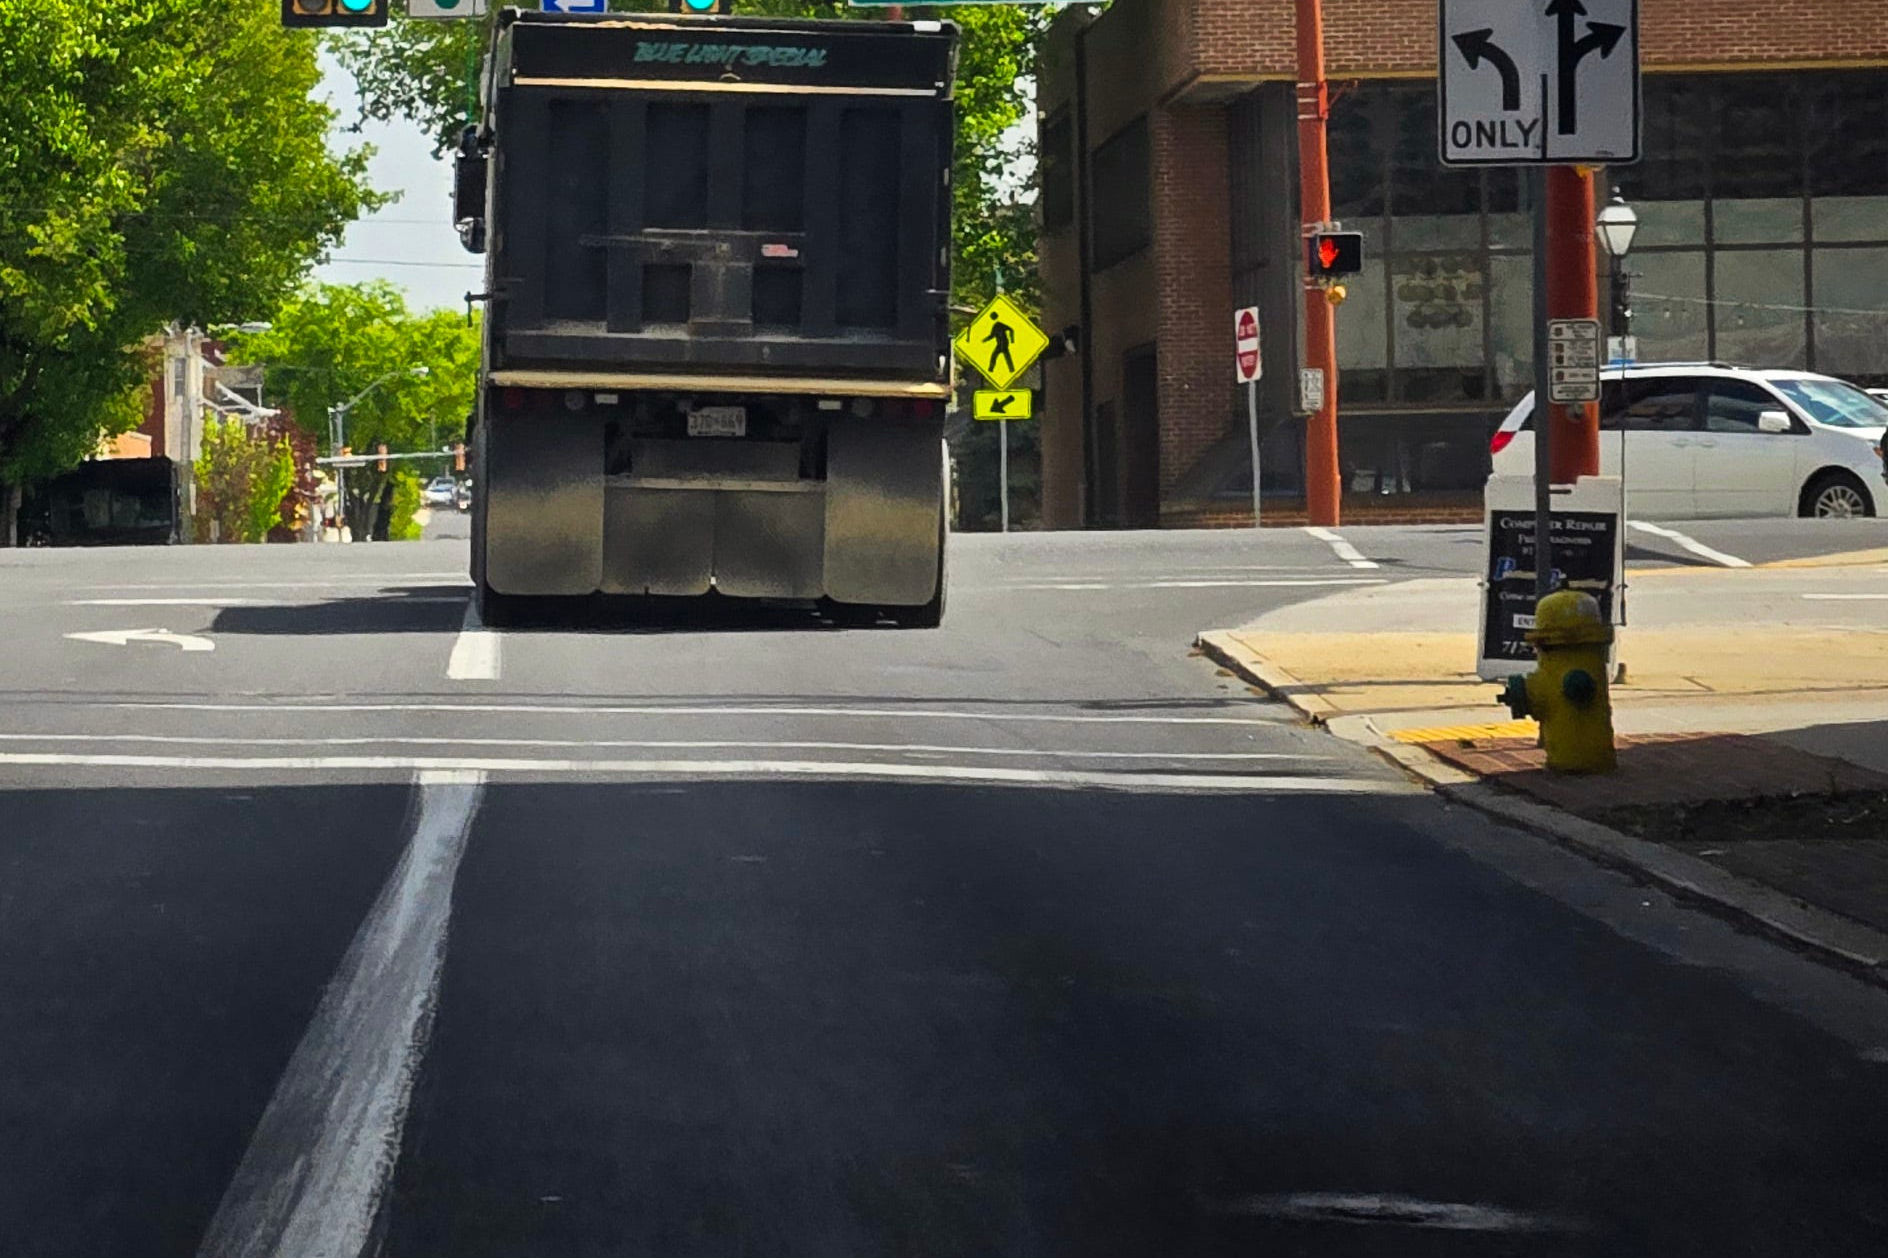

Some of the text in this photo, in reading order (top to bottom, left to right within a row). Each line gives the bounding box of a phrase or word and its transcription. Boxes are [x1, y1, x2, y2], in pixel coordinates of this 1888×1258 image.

[634, 42, 689, 62] BLUE
[740, 45, 827, 67] SPECIAL
[1451, 118, 1540, 149] ONLY
[1499, 517, 1607, 531] COMPER REPAIR
